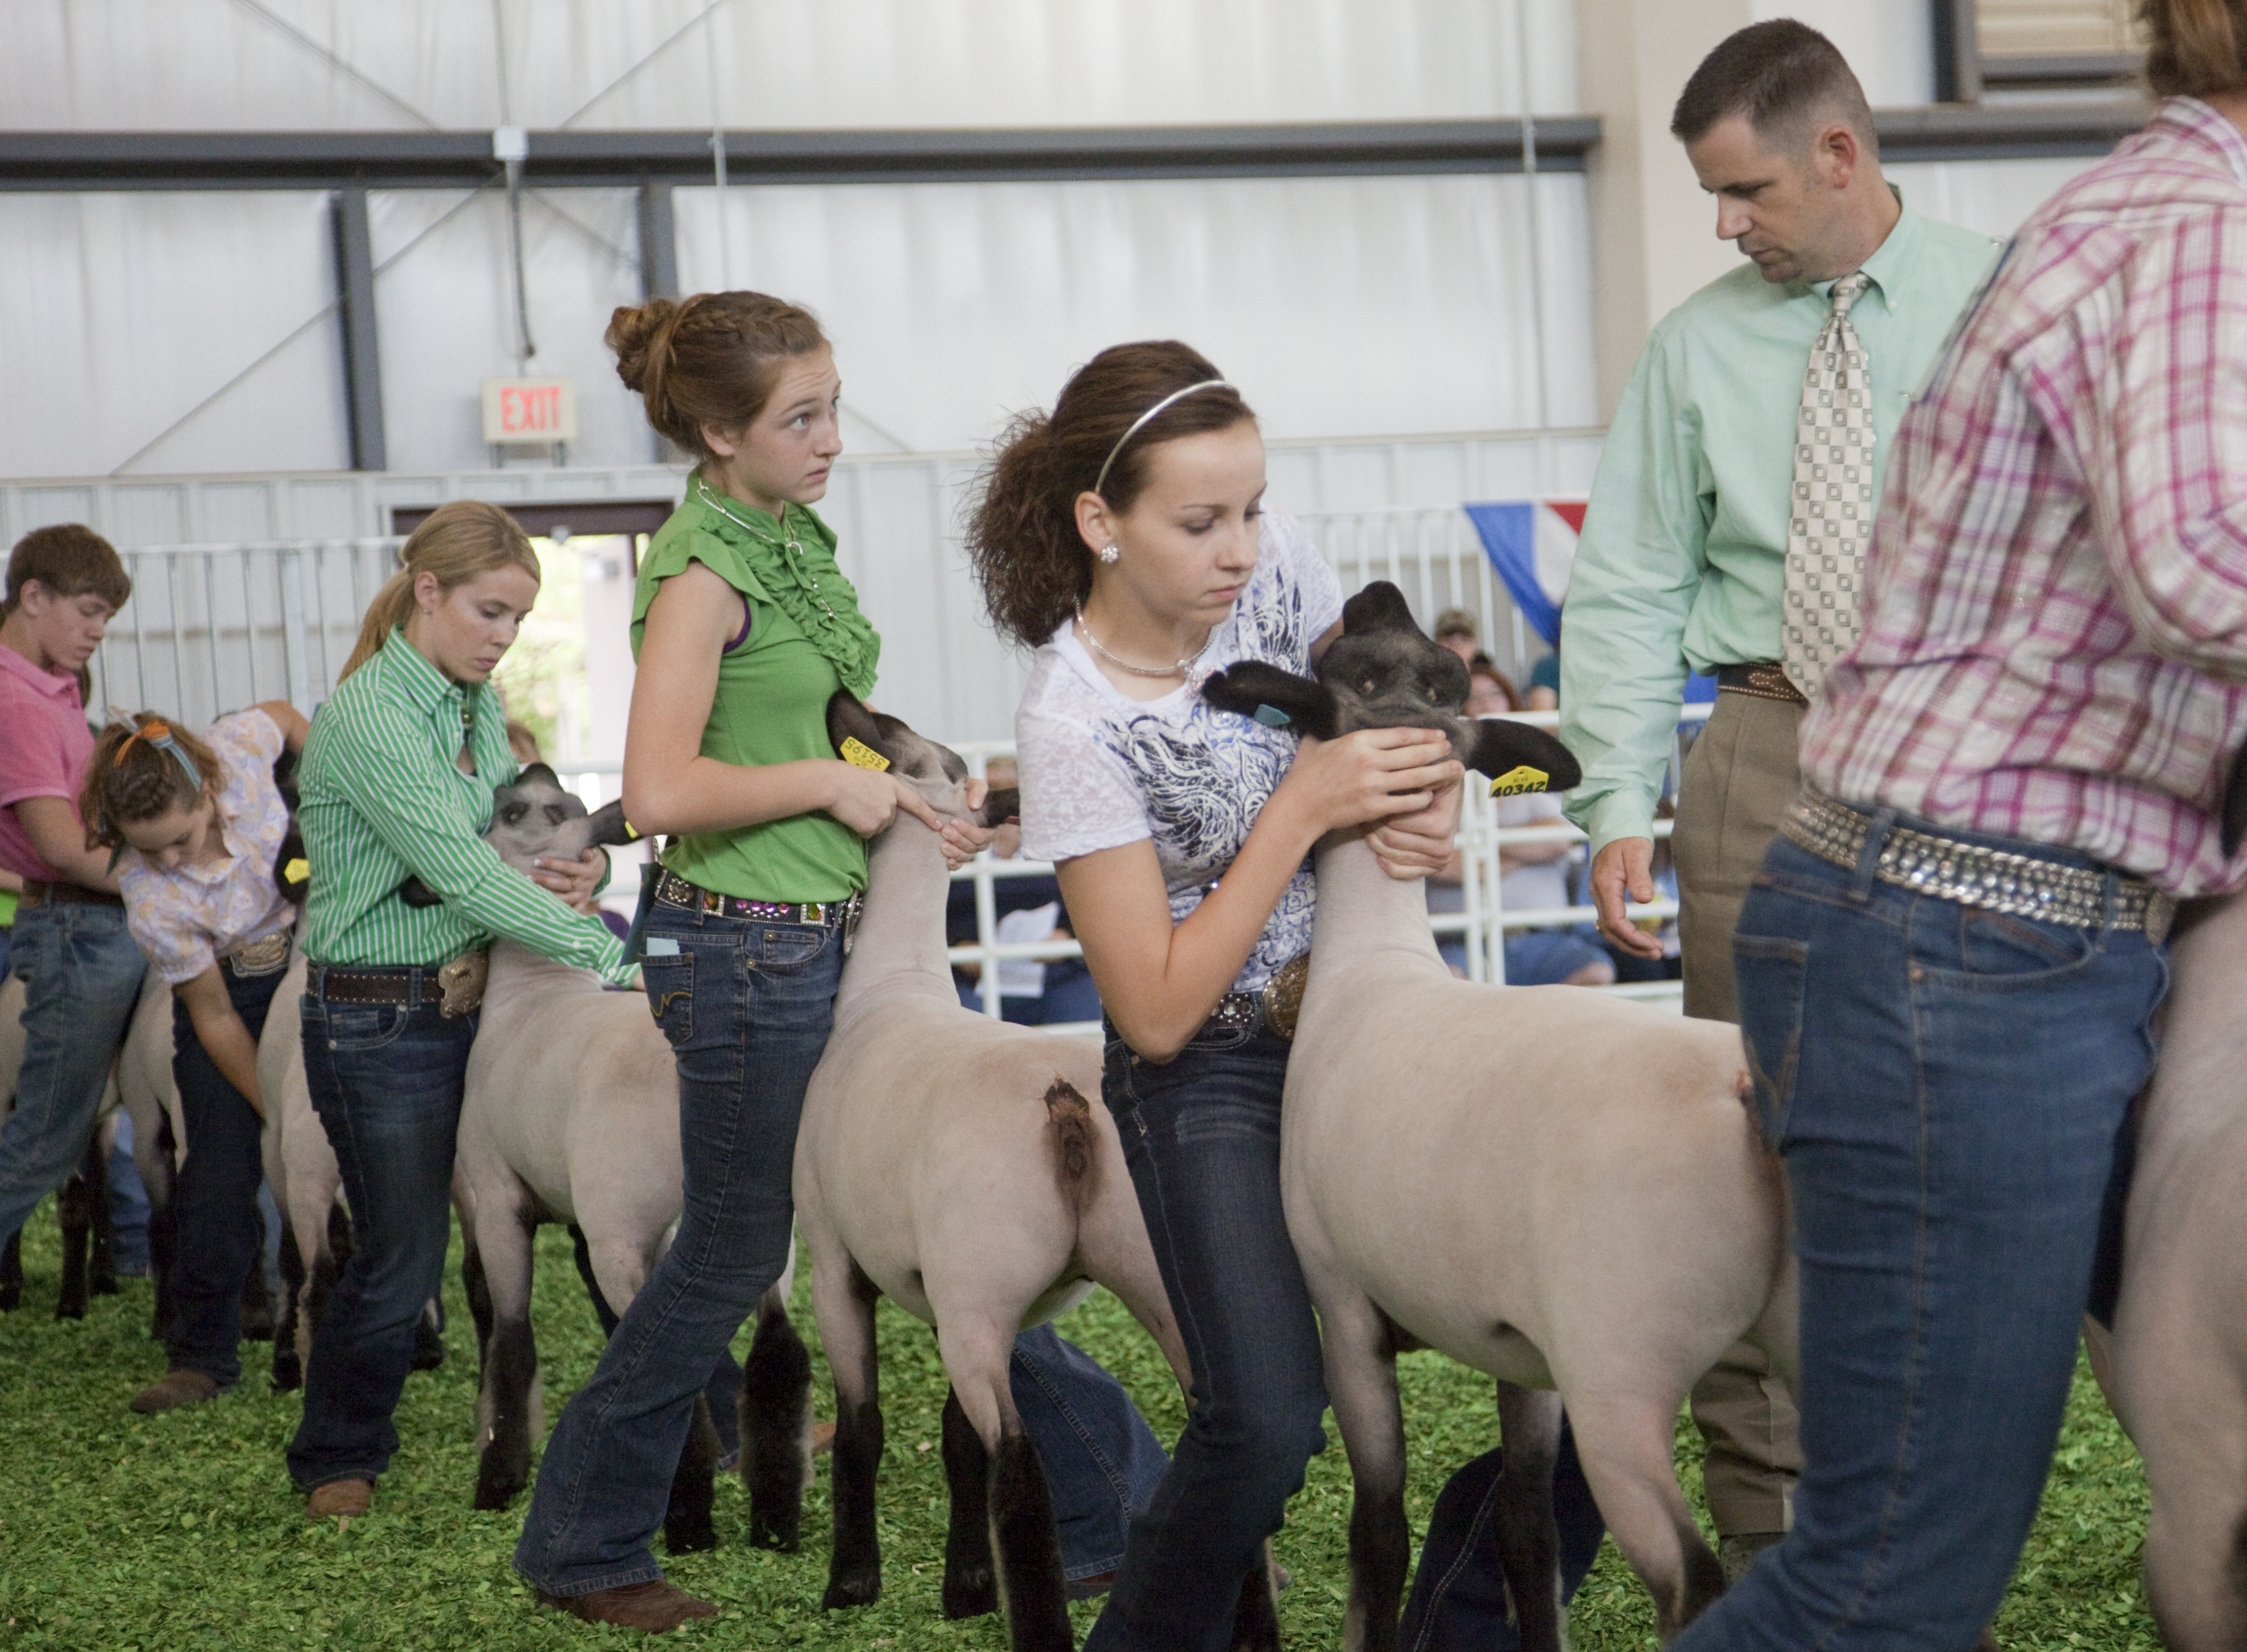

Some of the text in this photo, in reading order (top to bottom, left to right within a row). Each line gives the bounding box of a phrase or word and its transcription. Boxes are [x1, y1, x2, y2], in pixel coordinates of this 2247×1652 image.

[501, 386, 560, 432] EXIT
[845, 739, 885, 768] 35195
[1492, 781, 1546, 798] 40342
